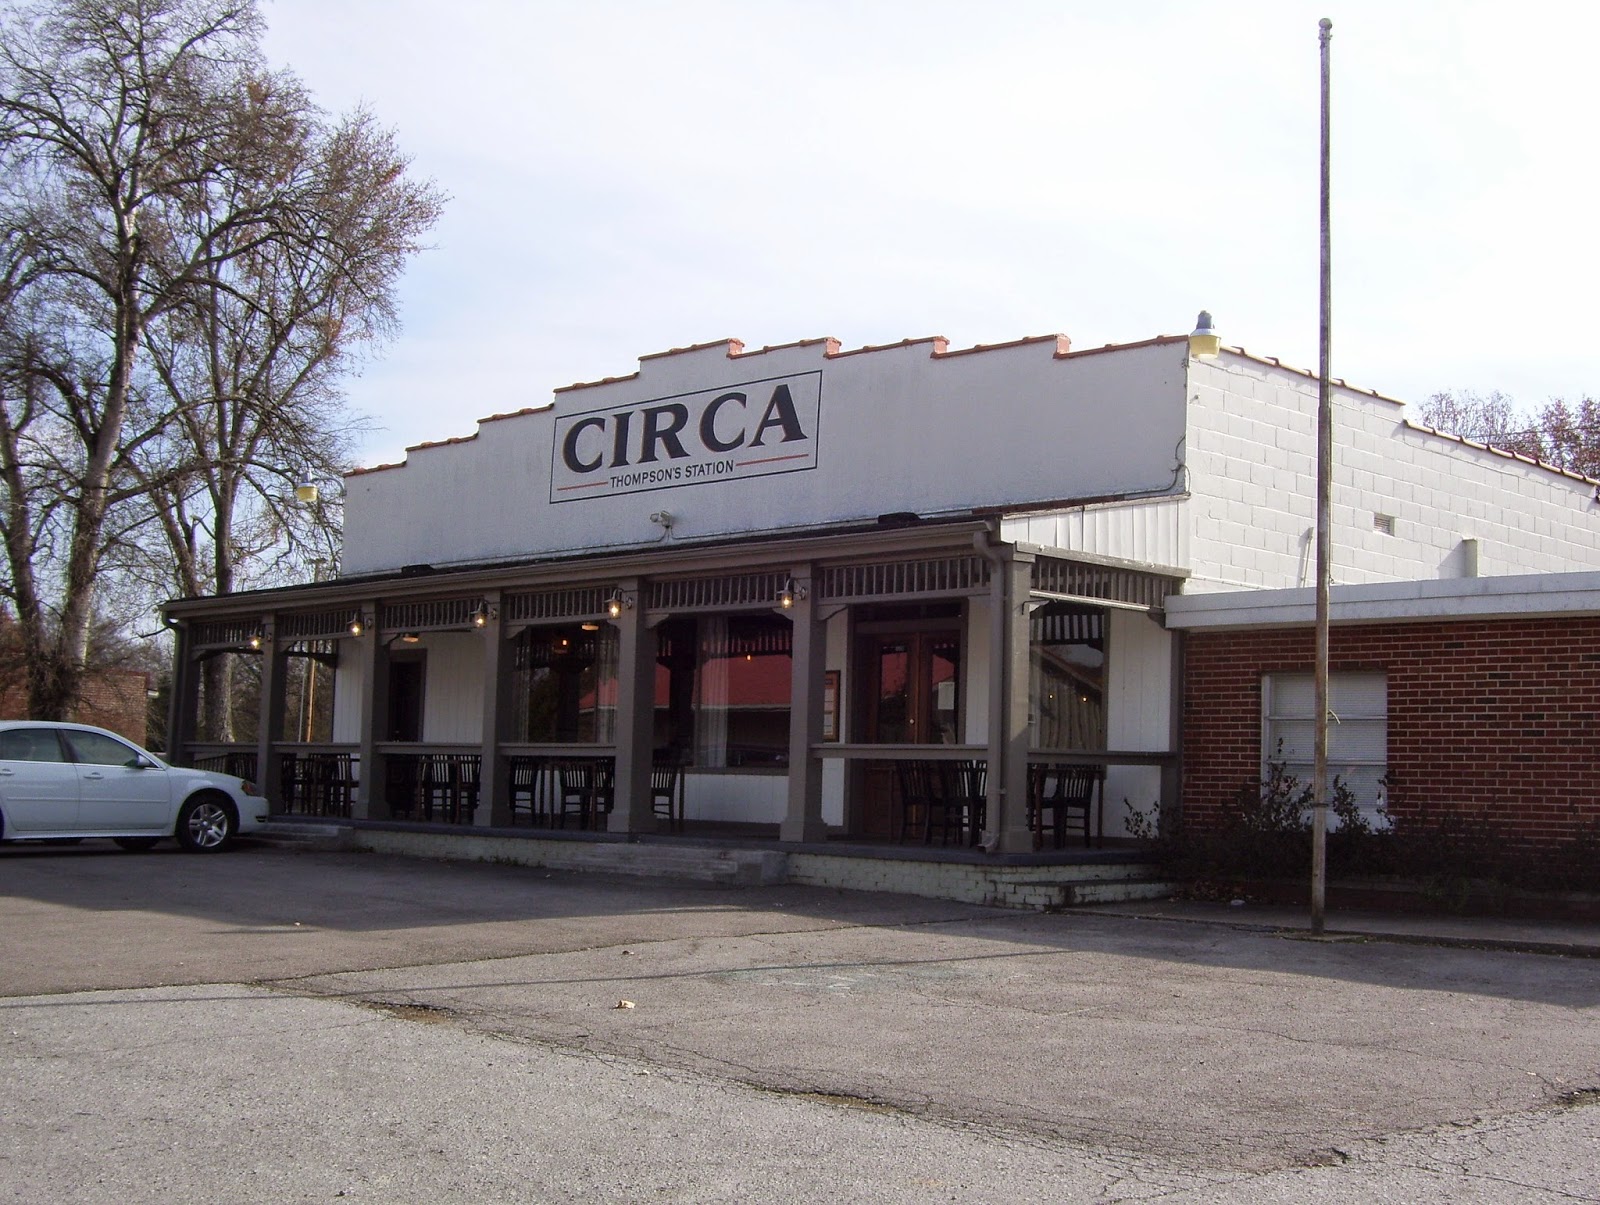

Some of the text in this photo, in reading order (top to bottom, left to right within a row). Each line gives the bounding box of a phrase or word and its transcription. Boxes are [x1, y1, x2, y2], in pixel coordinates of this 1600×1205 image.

[562, 384, 808, 473] CIRCA
[610, 460, 734, 488] THOMPSON'S STATION
